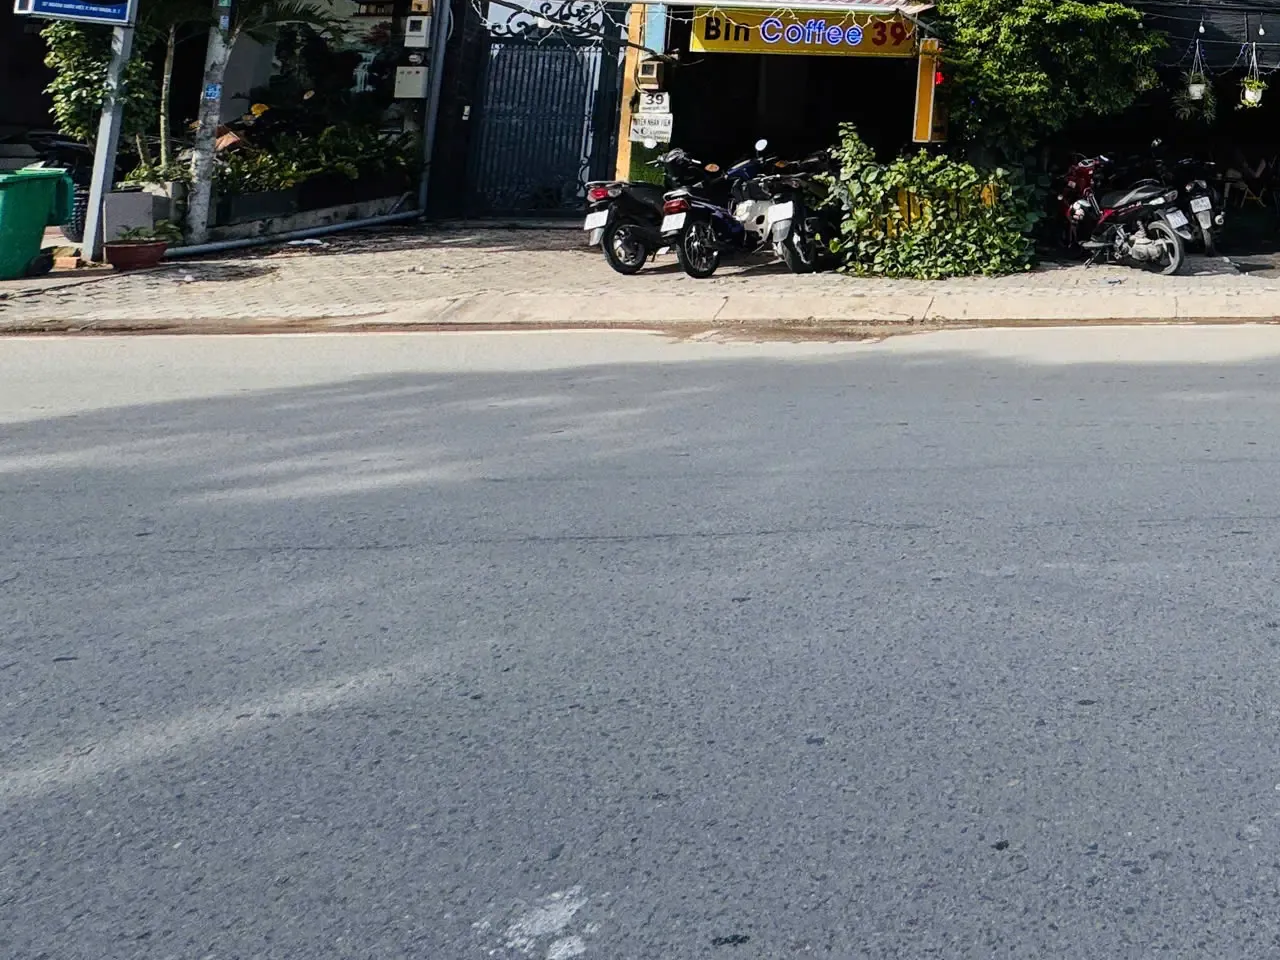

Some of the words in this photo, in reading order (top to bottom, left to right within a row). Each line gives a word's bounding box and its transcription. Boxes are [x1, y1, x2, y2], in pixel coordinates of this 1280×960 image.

[704, 16, 750, 41] Bin
[760, 17, 863, 46] Coffee
[871, 22, 908, 46] 39
[645, 93, 664, 105] 39
